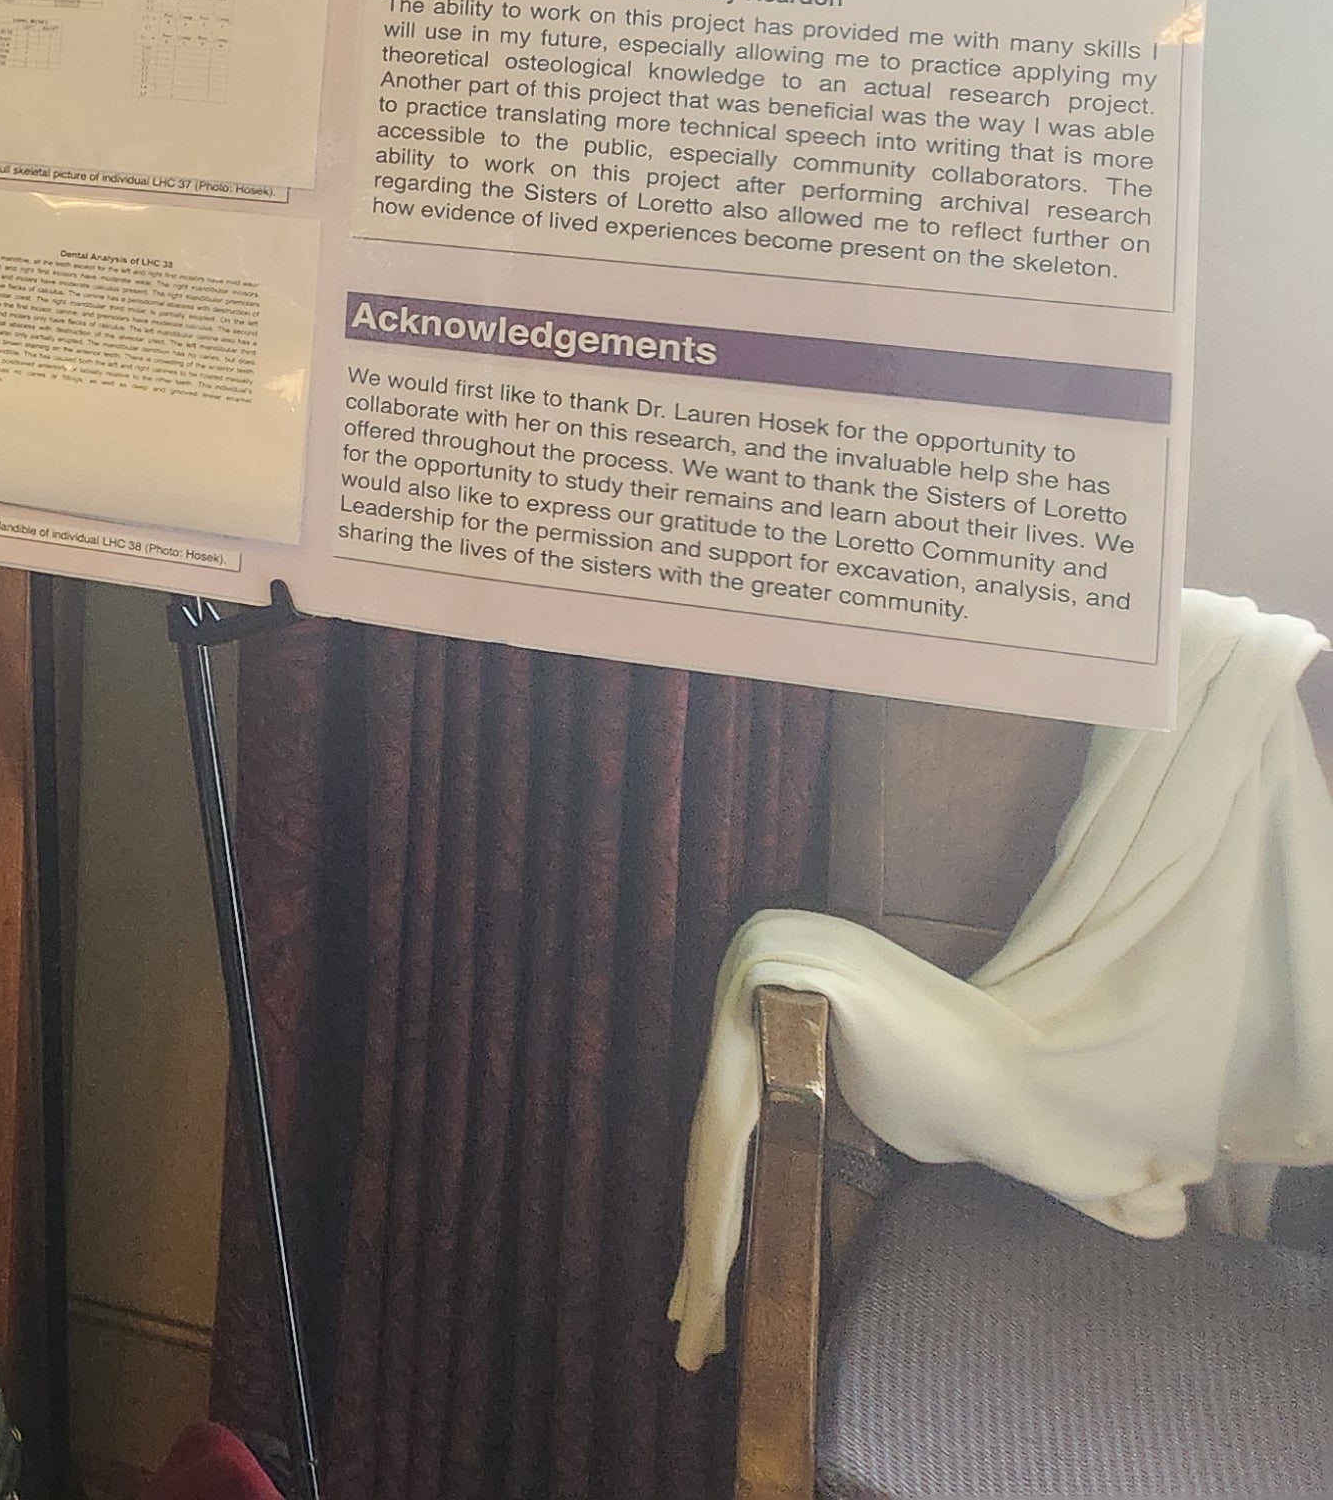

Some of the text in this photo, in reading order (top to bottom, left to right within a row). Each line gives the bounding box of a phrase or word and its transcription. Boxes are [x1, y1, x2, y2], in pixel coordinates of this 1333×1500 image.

[13, 165, 52, 179] skeletal
[53, 167, 87, 182] picture
[89, 170, 101, 182] of
[102, 171, 150, 187] individual
[152, 176, 176, 189] LHC
[178, 178, 192, 190] 37
[195, 180, 233, 194] (Photo:
[236, 184, 276, 198] Hosek).
[351, 301, 718, 367] Acknowledgements
[39, 526, 50, 537] of
[52, 528, 100, 546] individual
[103, 536, 126, 550] LHC
[128, 539, 142, 552] 38
[145, 542, 183, 558] (Photo:
[186, 548, 227, 566] Hosek).
[338, 522, 969, 622] sharing the lives of the sisters with the greater community.
